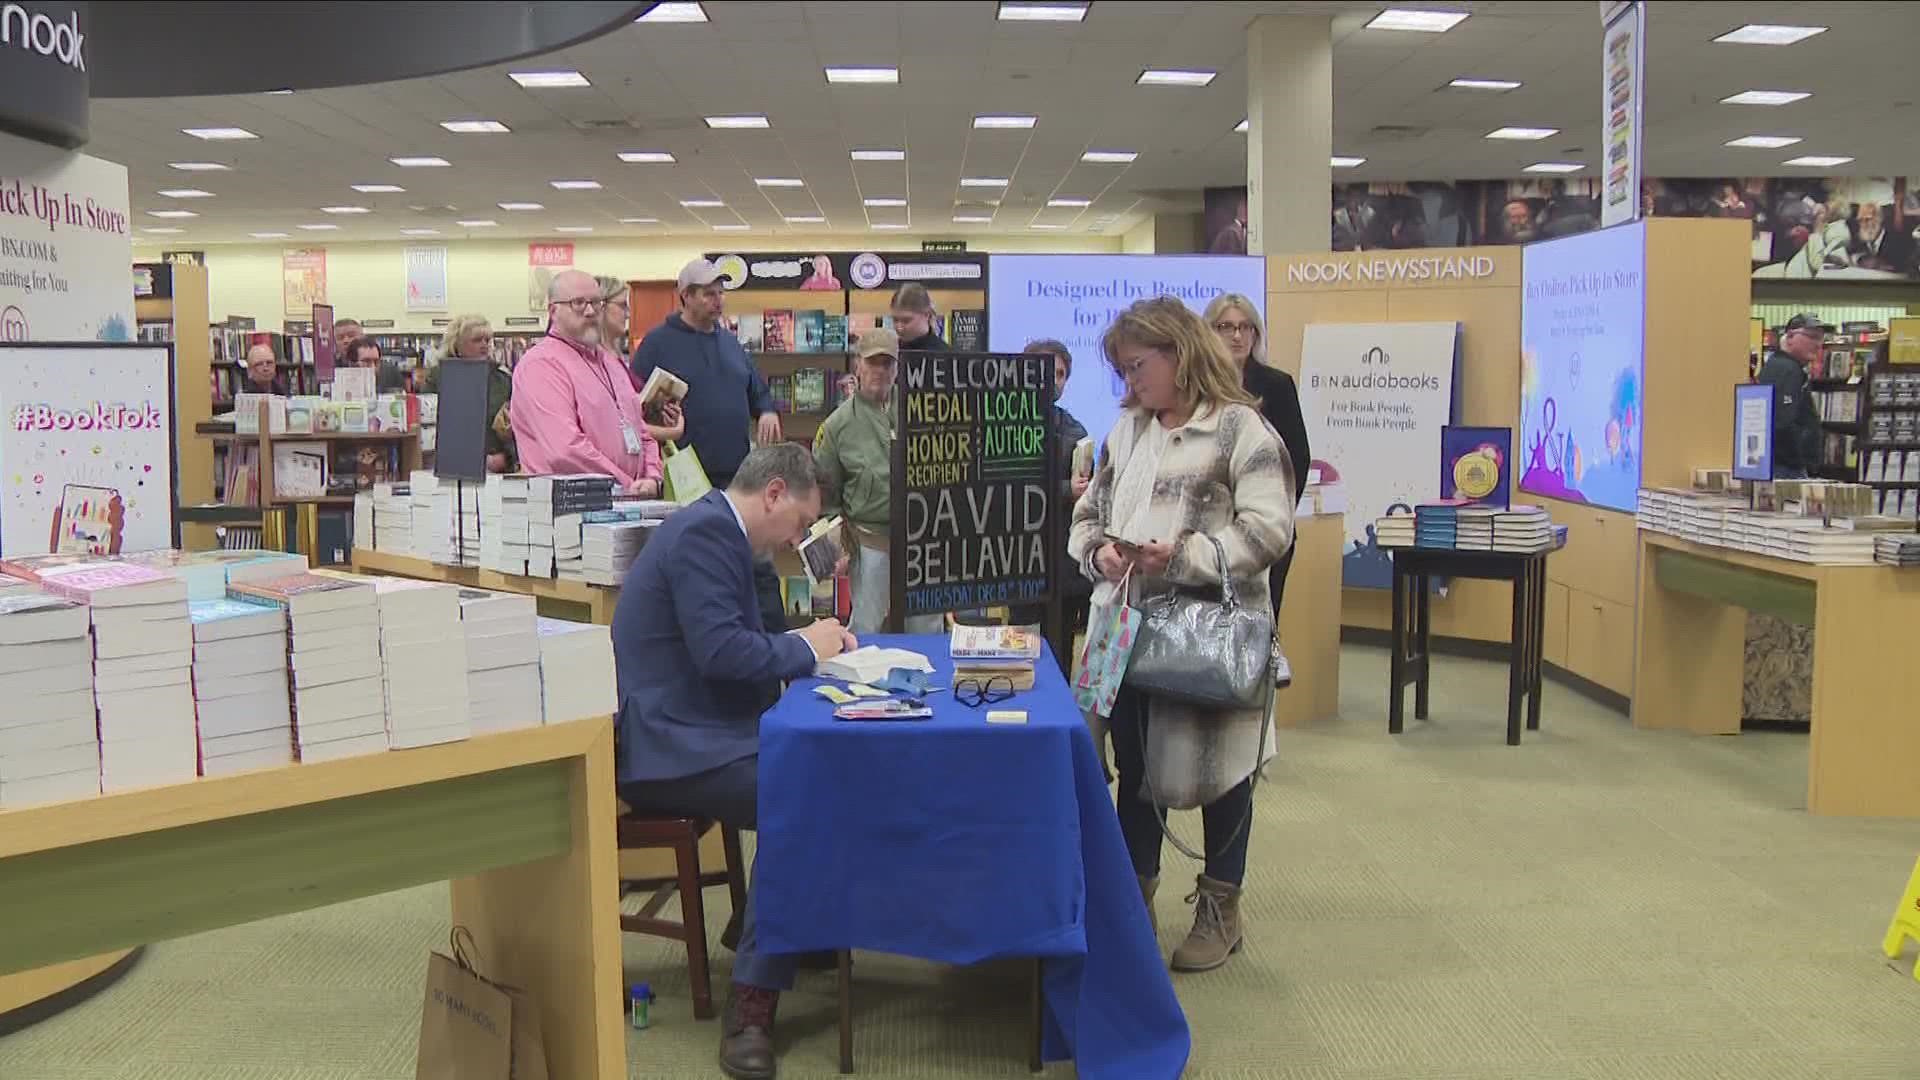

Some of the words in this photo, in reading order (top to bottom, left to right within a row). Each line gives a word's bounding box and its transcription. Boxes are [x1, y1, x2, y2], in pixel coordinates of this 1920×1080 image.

[2, 3, 85, 72] nook
[0, 179, 29, 216] ick
[33, 184, 60, 231] Up
[64, 192, 83, 226] In
[86, 198, 125, 234] Store
[32, 269, 47, 290] for
[48, 272, 68, 293] You
[1288, 262, 1351, 282] NOOK
[1357, 256, 1494, 280] NEWSSTAND
[1570, 272, 1588, 295] Pick
[1589, 271, 1600, 297] Up
[1602, 271, 1612, 289] In
[1614, 269, 1639, 288] Store
[1027, 279, 1117, 302] Designed
[1123, 280, 1144, 298] by
[1074, 308, 1102, 326] for
[906, 357, 1046, 390] WELCOME!
[1342, 371, 1439, 390] audiobooks
[14, 401, 161, 432] #BookTok
[906, 391, 972, 424] MEDAL
[984, 391, 1043, 420] LOCAL
[1331, 401, 1348, 413] For
[1350, 401, 1376, 413] Book
[1377, 402, 1414, 416] People,
[1327, 417, 1353, 428] From
[1355, 418, 1381, 429] Book
[1383, 419, 1417, 431] People
[906, 432, 972, 465] HONOR
[984, 425, 1044, 456] AUTHOR
[906, 462, 969, 488] RECIPIENT
[906, 484, 1047, 542] DAVID
[906, 535, 1046, 587] BELLAVIA
[906, 584, 973, 609] THURSDAY
